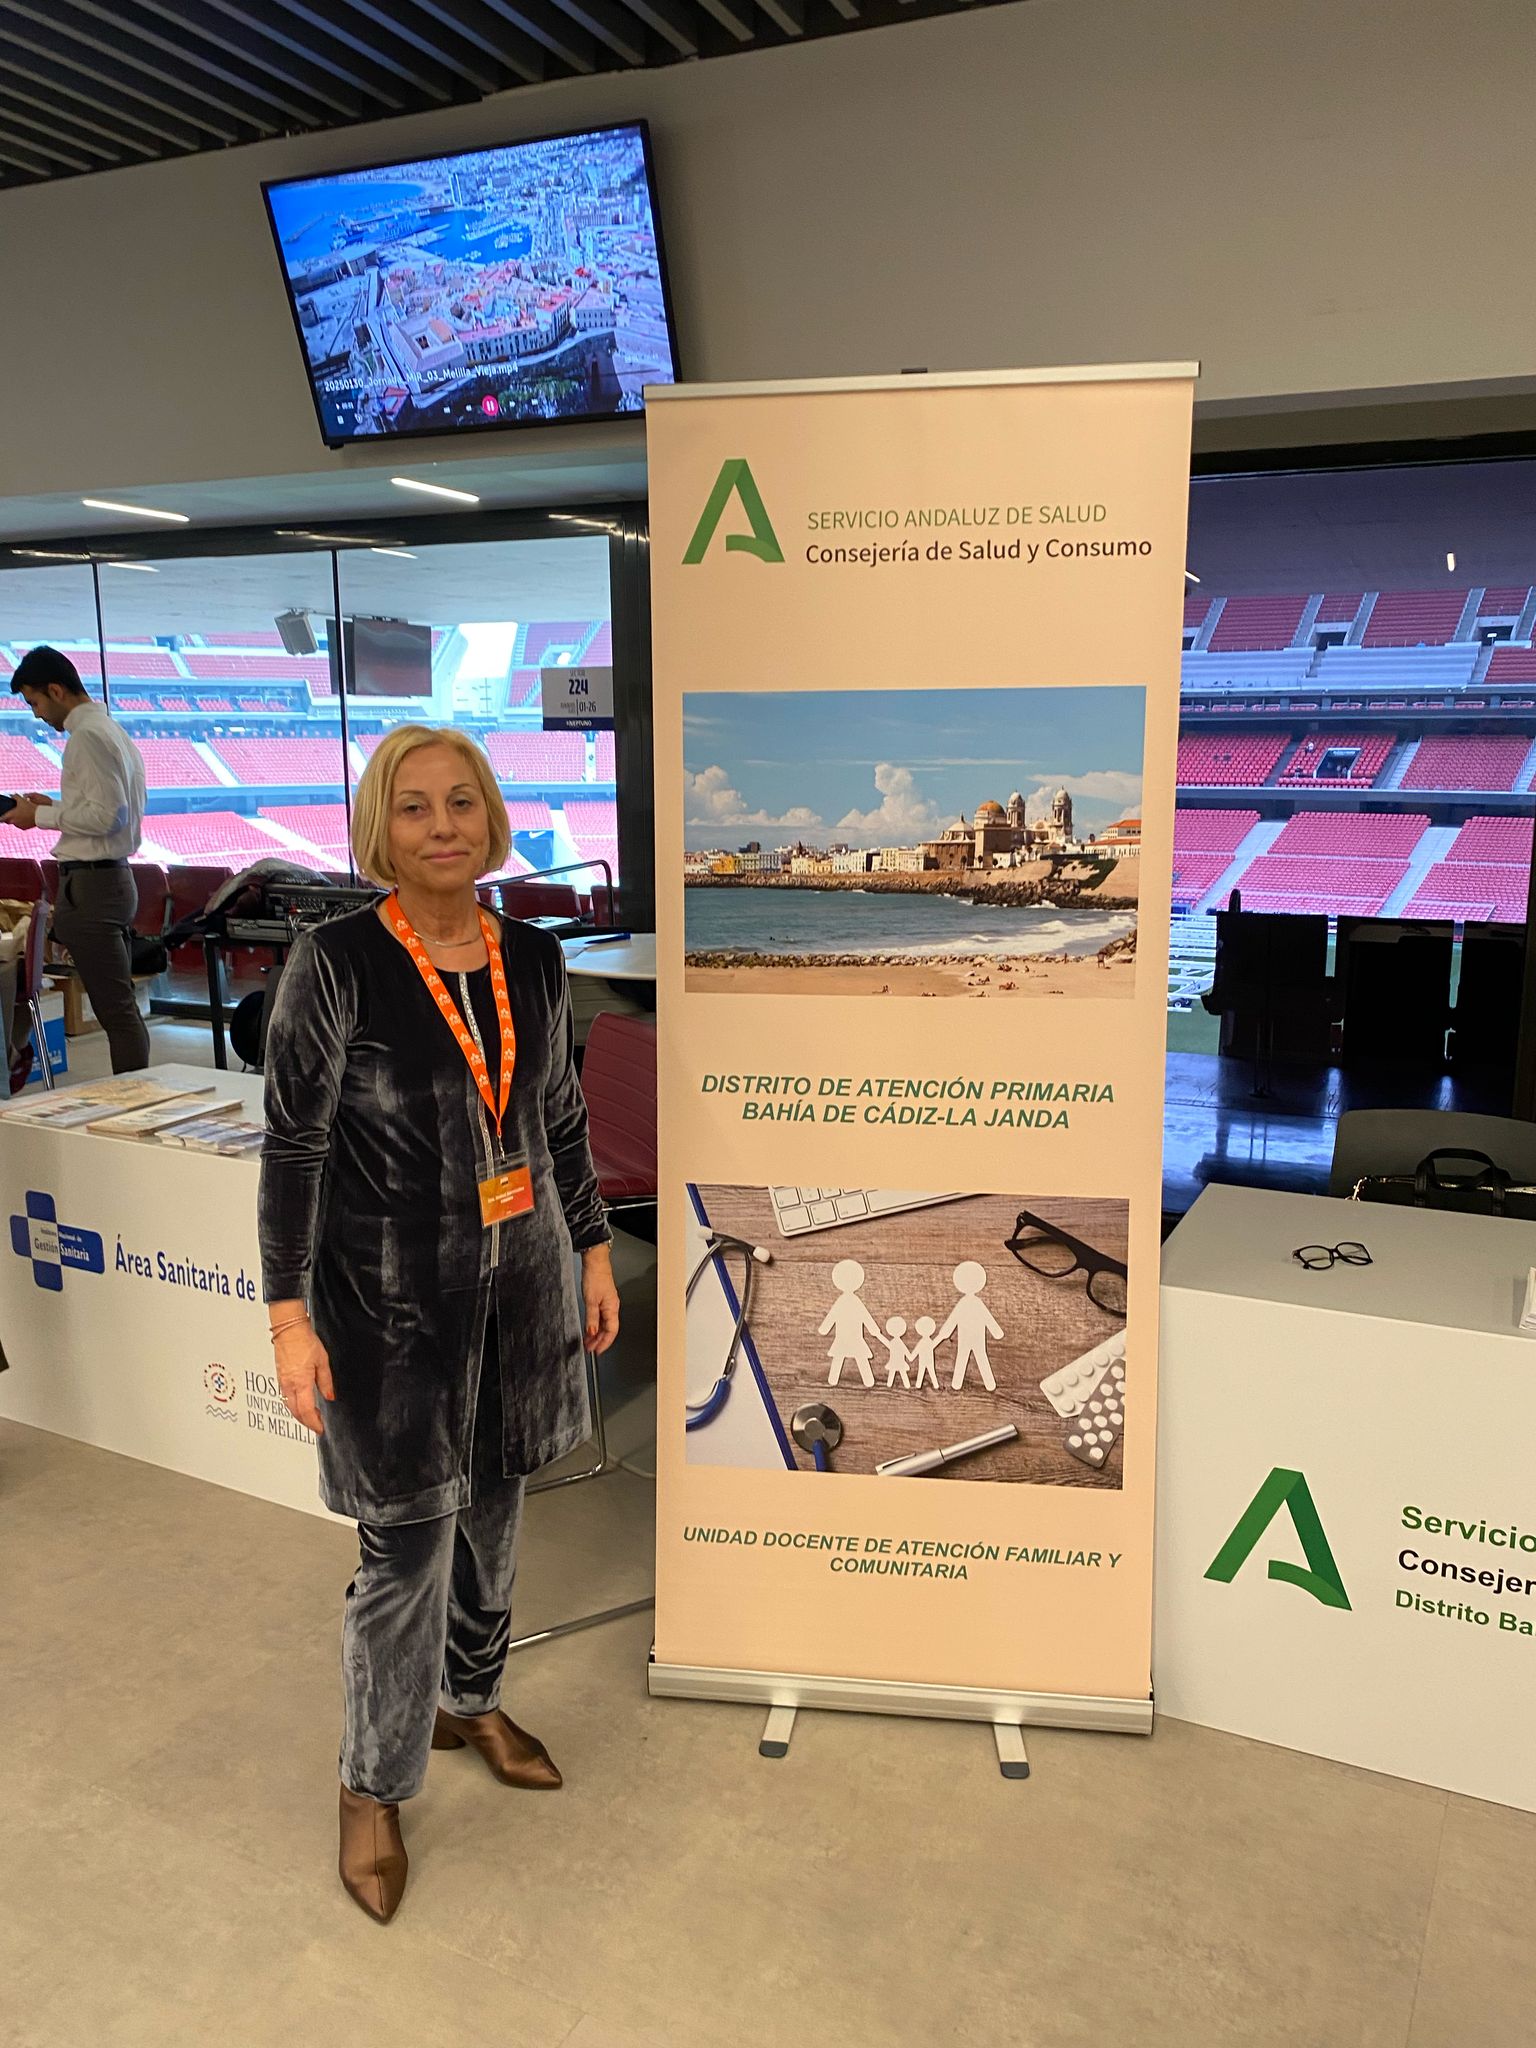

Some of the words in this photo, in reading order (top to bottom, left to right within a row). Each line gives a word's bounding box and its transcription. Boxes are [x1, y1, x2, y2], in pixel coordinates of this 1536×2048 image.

[807, 510, 899, 530] SERVICIO
[904, 507, 1001, 527] ANDALUZ
[1006, 506, 1033, 525] DE
[1038, 504, 1107, 523] SALUD
[805, 540, 920, 568] Consejería
[925, 540, 952, 561] de
[958, 539, 1021, 560] Salud
[1026, 542, 1040, 563] y
[1046, 538, 1153, 558] Consumo
[568, 678, 589, 695] 224
[579, 701, 597, 713] 01-26
[701, 1074, 812, 1095] DISTRITO
[818, 1077, 852, 1097] DE
[856, 1076, 984, 1100] ATENCIÓN
[990, 1081, 1115, 1103] PRIMARIA
[742, 1098, 816, 1123] BAHÍA
[823, 1104, 857, 1124] DE
[863, 1102, 977, 1127] CÁDIZ-LA
[984, 1108, 1070, 1129] JANDA
[60, 1242, 90, 1262] Sanitaria
[115, 1233, 153, 1278] Área
[157, 1251, 231, 1296] Sanitaria
[236, 1268, 256, 1301] de
[245, 1370, 281, 1398] HOS
[246, 1394, 293, 1419] UNIVERS
[248, 1410, 265, 1431] DE
[1401, 1506, 1536, 1553] Servicio
[683, 1525, 758, 1546] UNIDAD
[763, 1531, 860, 1552] DOCENTE
[864, 1537, 893, 1555] DE
[895, 1539, 1000, 1561] ATENCIÓN
[1005, 1546, 1102, 1567] FAMILIAR
[1109, 1552, 1123, 1569] Y
[829, 1556, 969, 1580] COMUNITARIA
[1398, 1549, 1536, 1596] Consejer
[1395, 1589, 1490, 1626] Distrito
[1499, 1611, 1536, 1637] Ba
